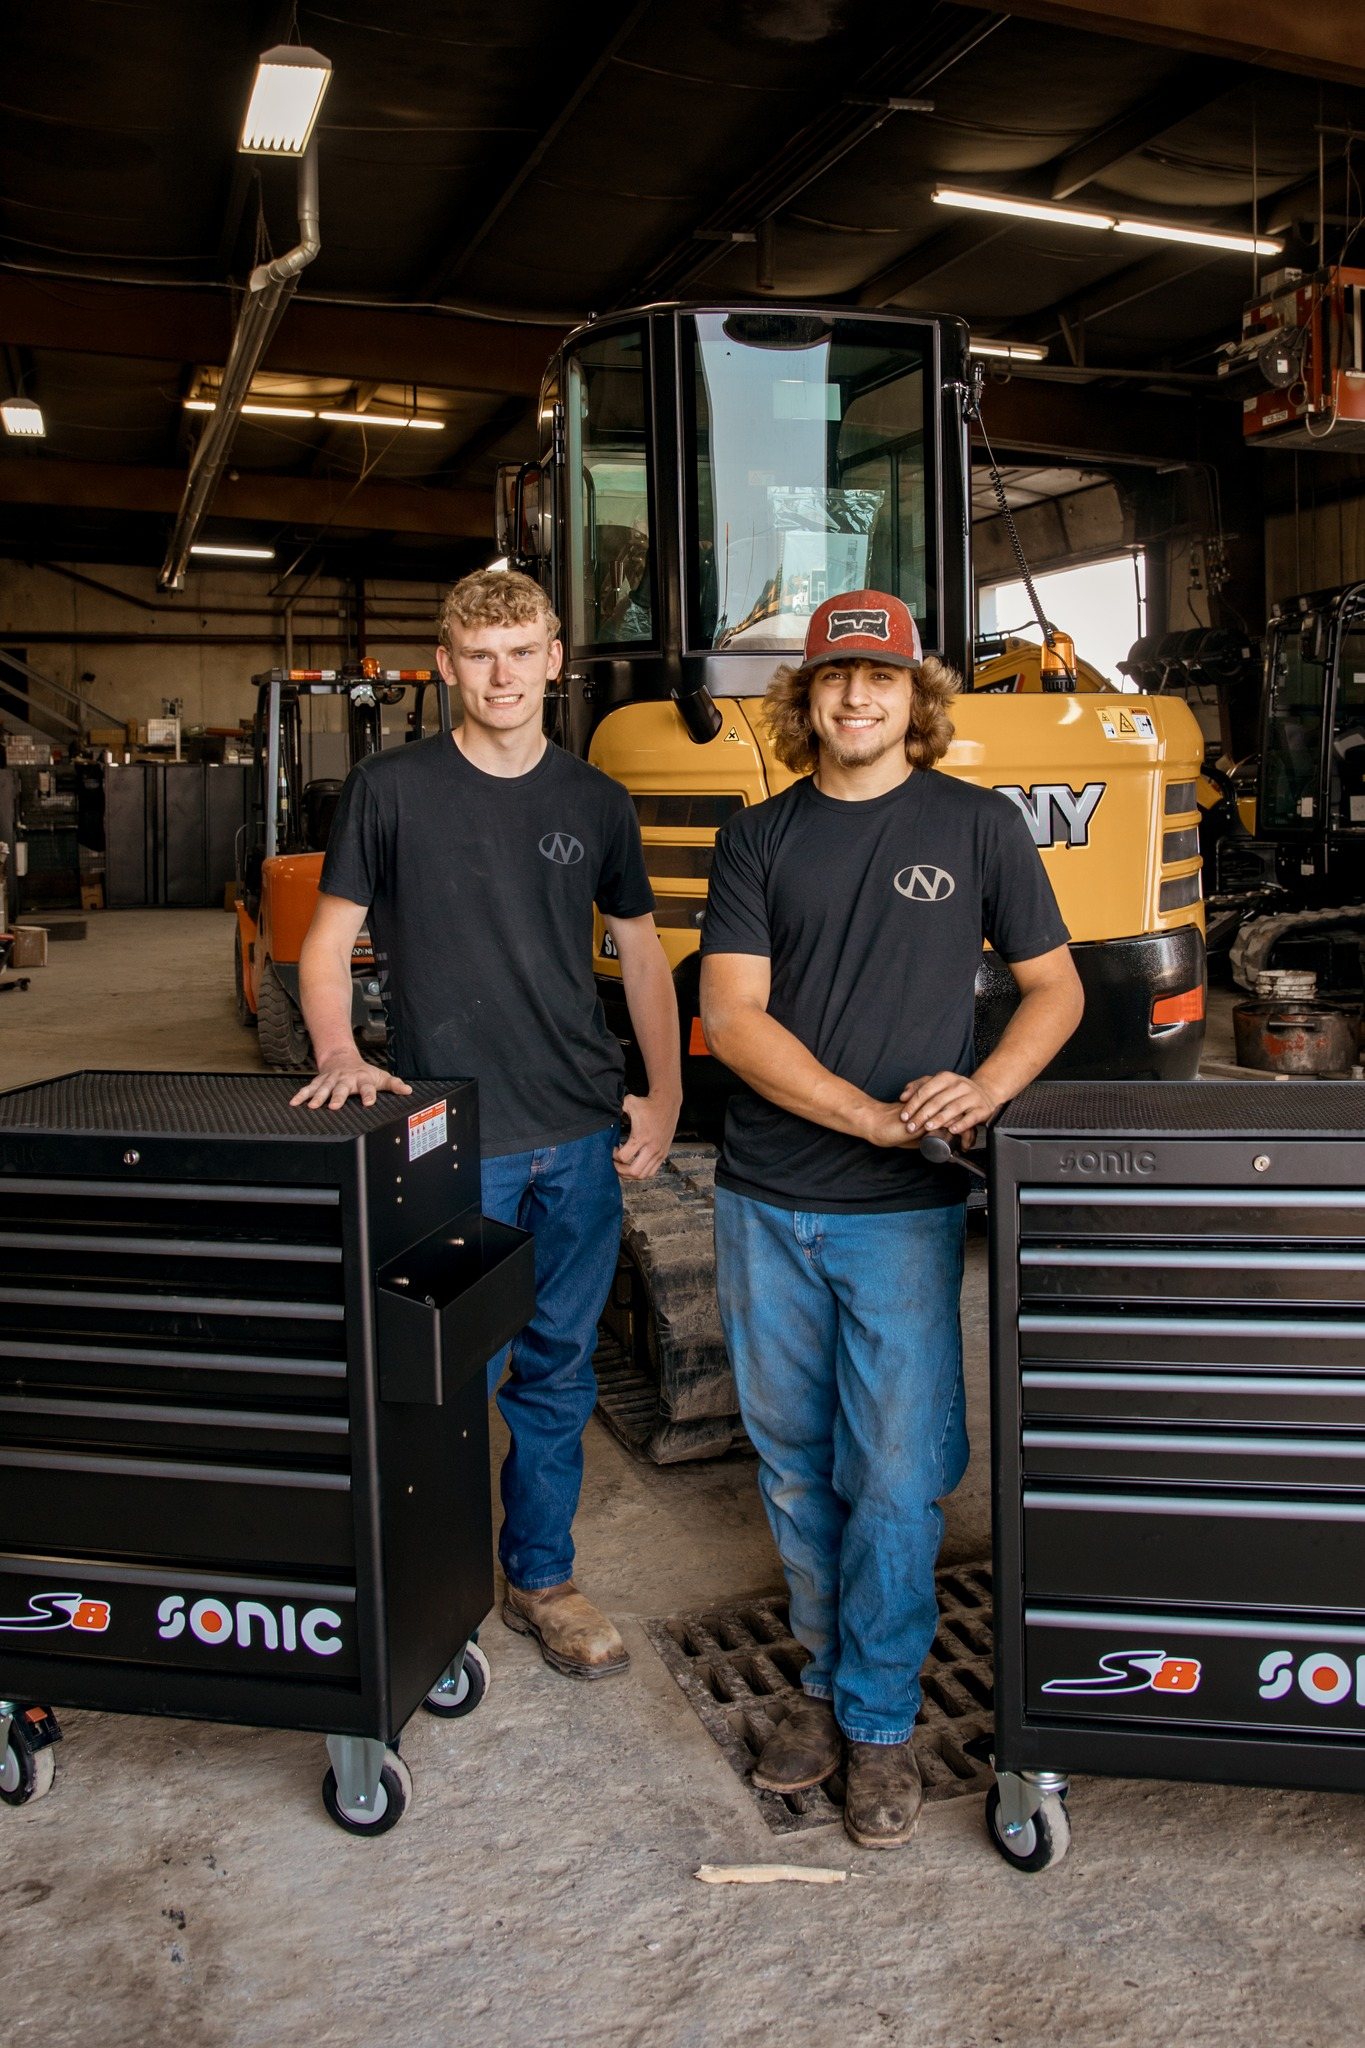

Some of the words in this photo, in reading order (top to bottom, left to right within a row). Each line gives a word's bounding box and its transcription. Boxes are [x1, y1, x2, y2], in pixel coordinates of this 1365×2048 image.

[158, 1596, 342, 1655] SONIC
[1041, 1650, 1201, 1695] S8
[1258, 1650, 1365, 1706] SO
